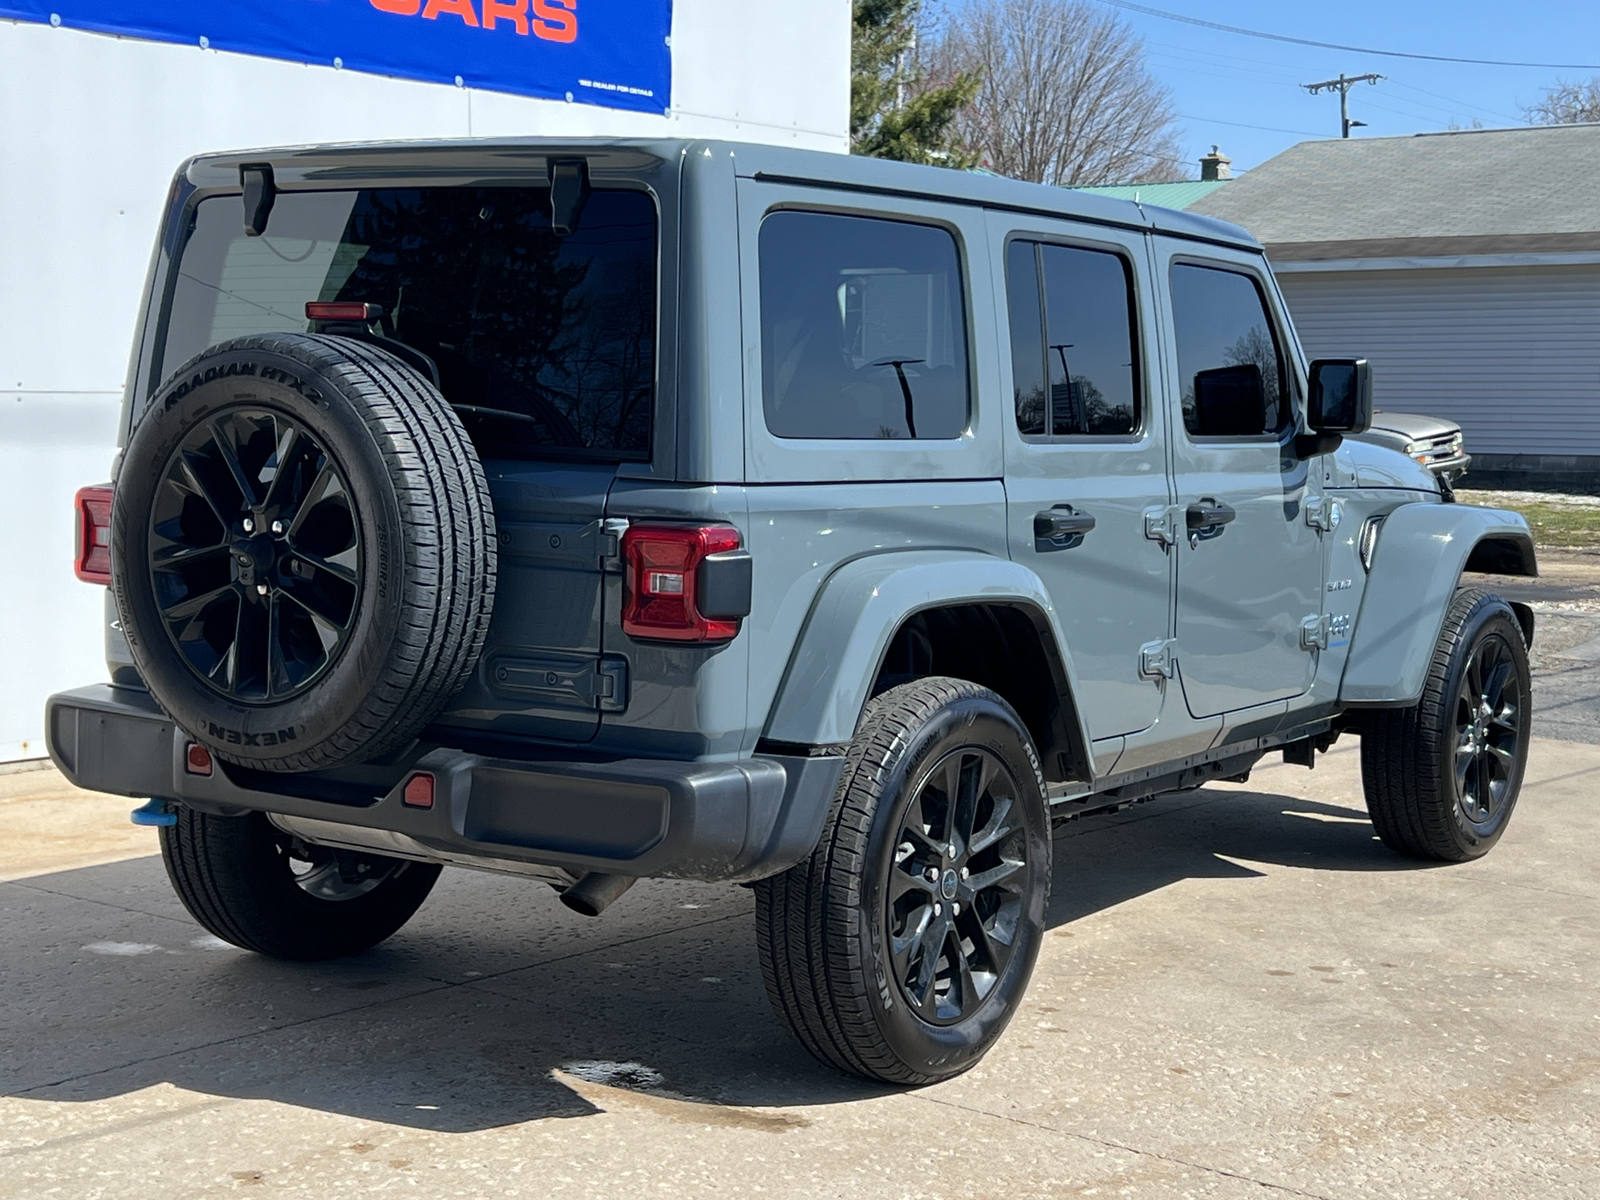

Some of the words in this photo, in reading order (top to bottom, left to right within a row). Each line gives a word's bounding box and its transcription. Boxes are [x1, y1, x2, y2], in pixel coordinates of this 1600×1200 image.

[369, 0, 577, 43] ARS
[378, 523, 388, 599] 255/60R20
[207, 722, 297, 748] NEXEN
[871, 898, 894, 1011] NEXEN
